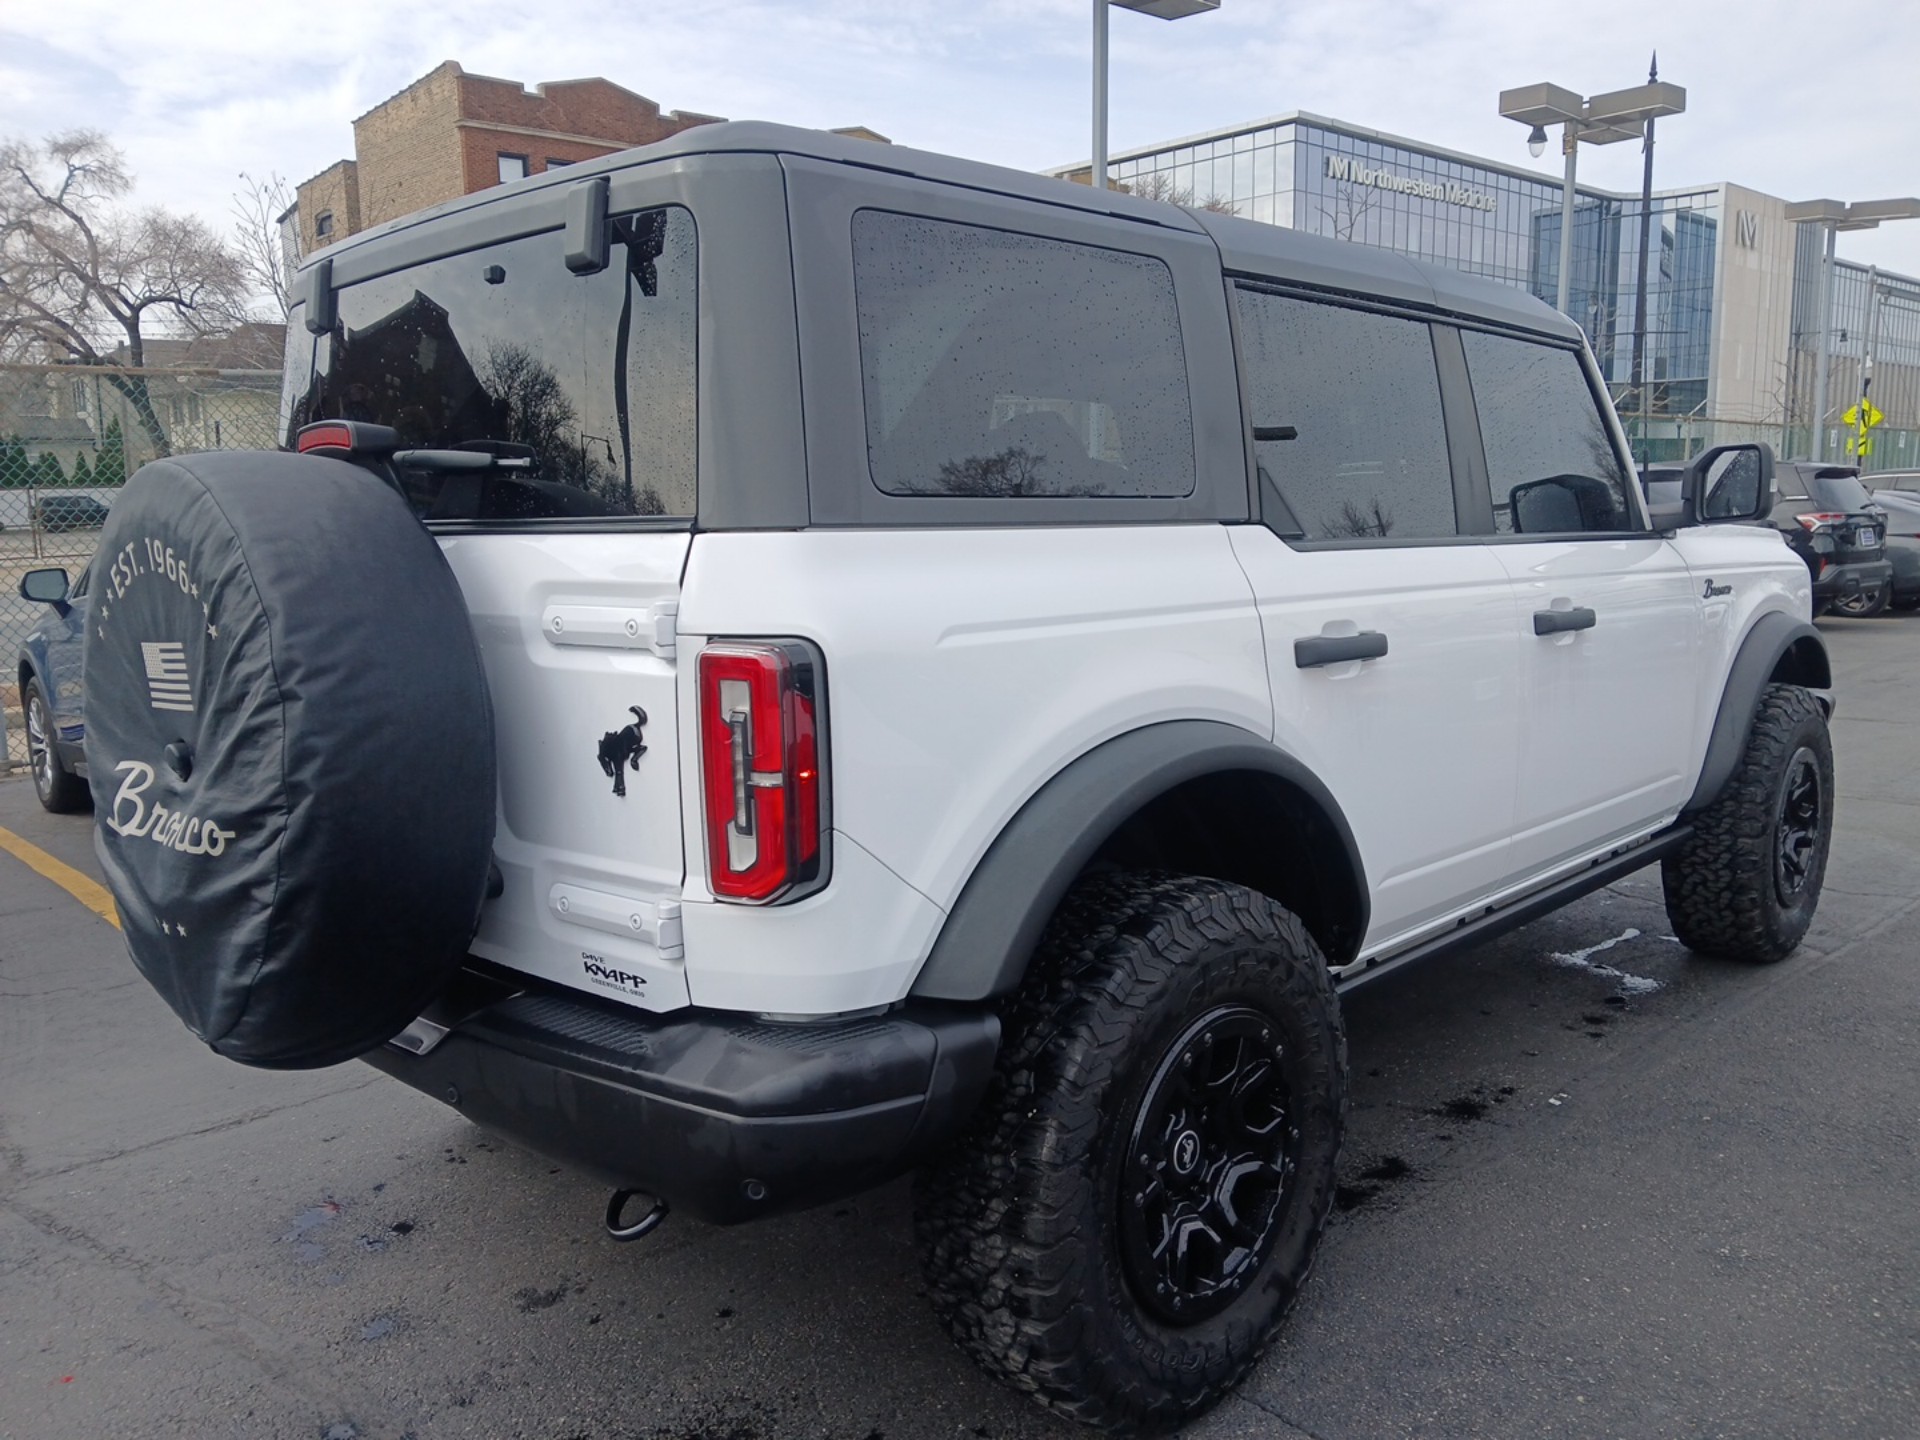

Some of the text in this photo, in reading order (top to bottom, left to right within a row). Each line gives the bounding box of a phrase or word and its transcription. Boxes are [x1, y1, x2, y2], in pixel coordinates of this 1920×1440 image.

[1351, 159, 1445, 202] Northwestern
[1446, 182, 1497, 213] Medicine
[110, 537, 189, 599] EST. 1966
[582, 951, 606, 964] DAVE
[583, 960, 647, 989] KNAPP
